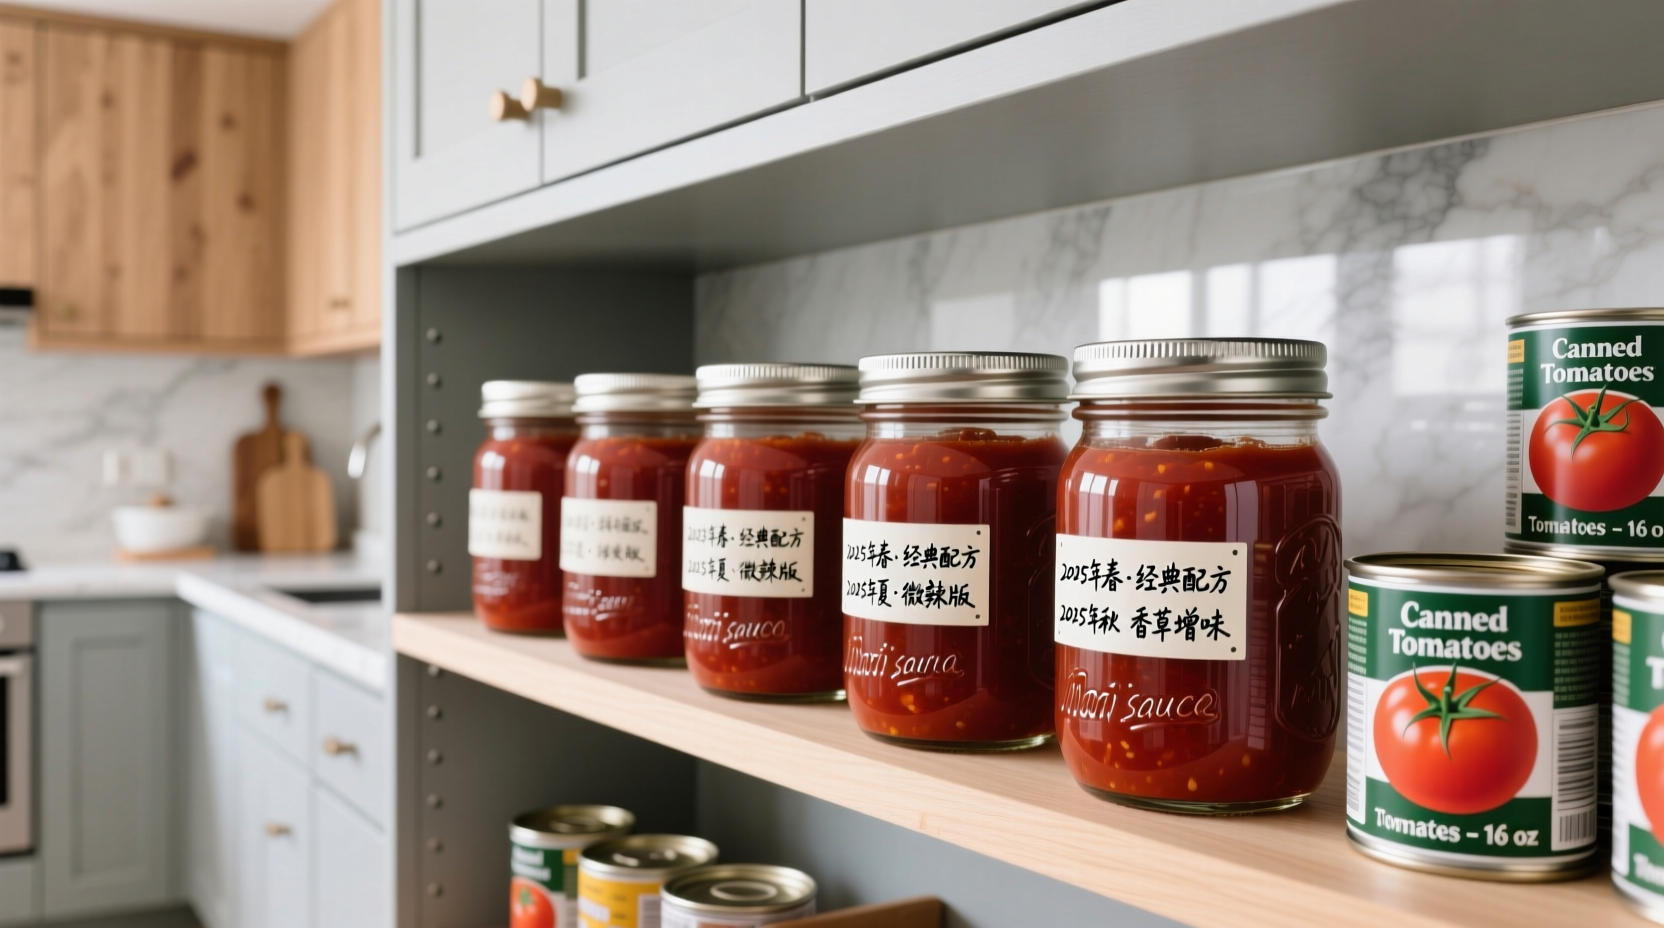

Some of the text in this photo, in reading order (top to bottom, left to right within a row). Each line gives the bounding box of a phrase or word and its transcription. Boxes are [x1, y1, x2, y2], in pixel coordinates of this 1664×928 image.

[1552, 335, 1642, 360] Canned
[1540, 363, 1655, 384] Tomatoes
[1528, 516, 1606, 536] Tomatoes
[1627, 519, 1648, 538] 16
[1059, 604, 1231, 642] 2025年秋 香草增味
[1400, 600, 1509, 633] Canned
[1388, 628, 1523, 662] Tomatoes
[1484, 824, 1509, 847] 16
[1513, 830, 1540, 846] oz
